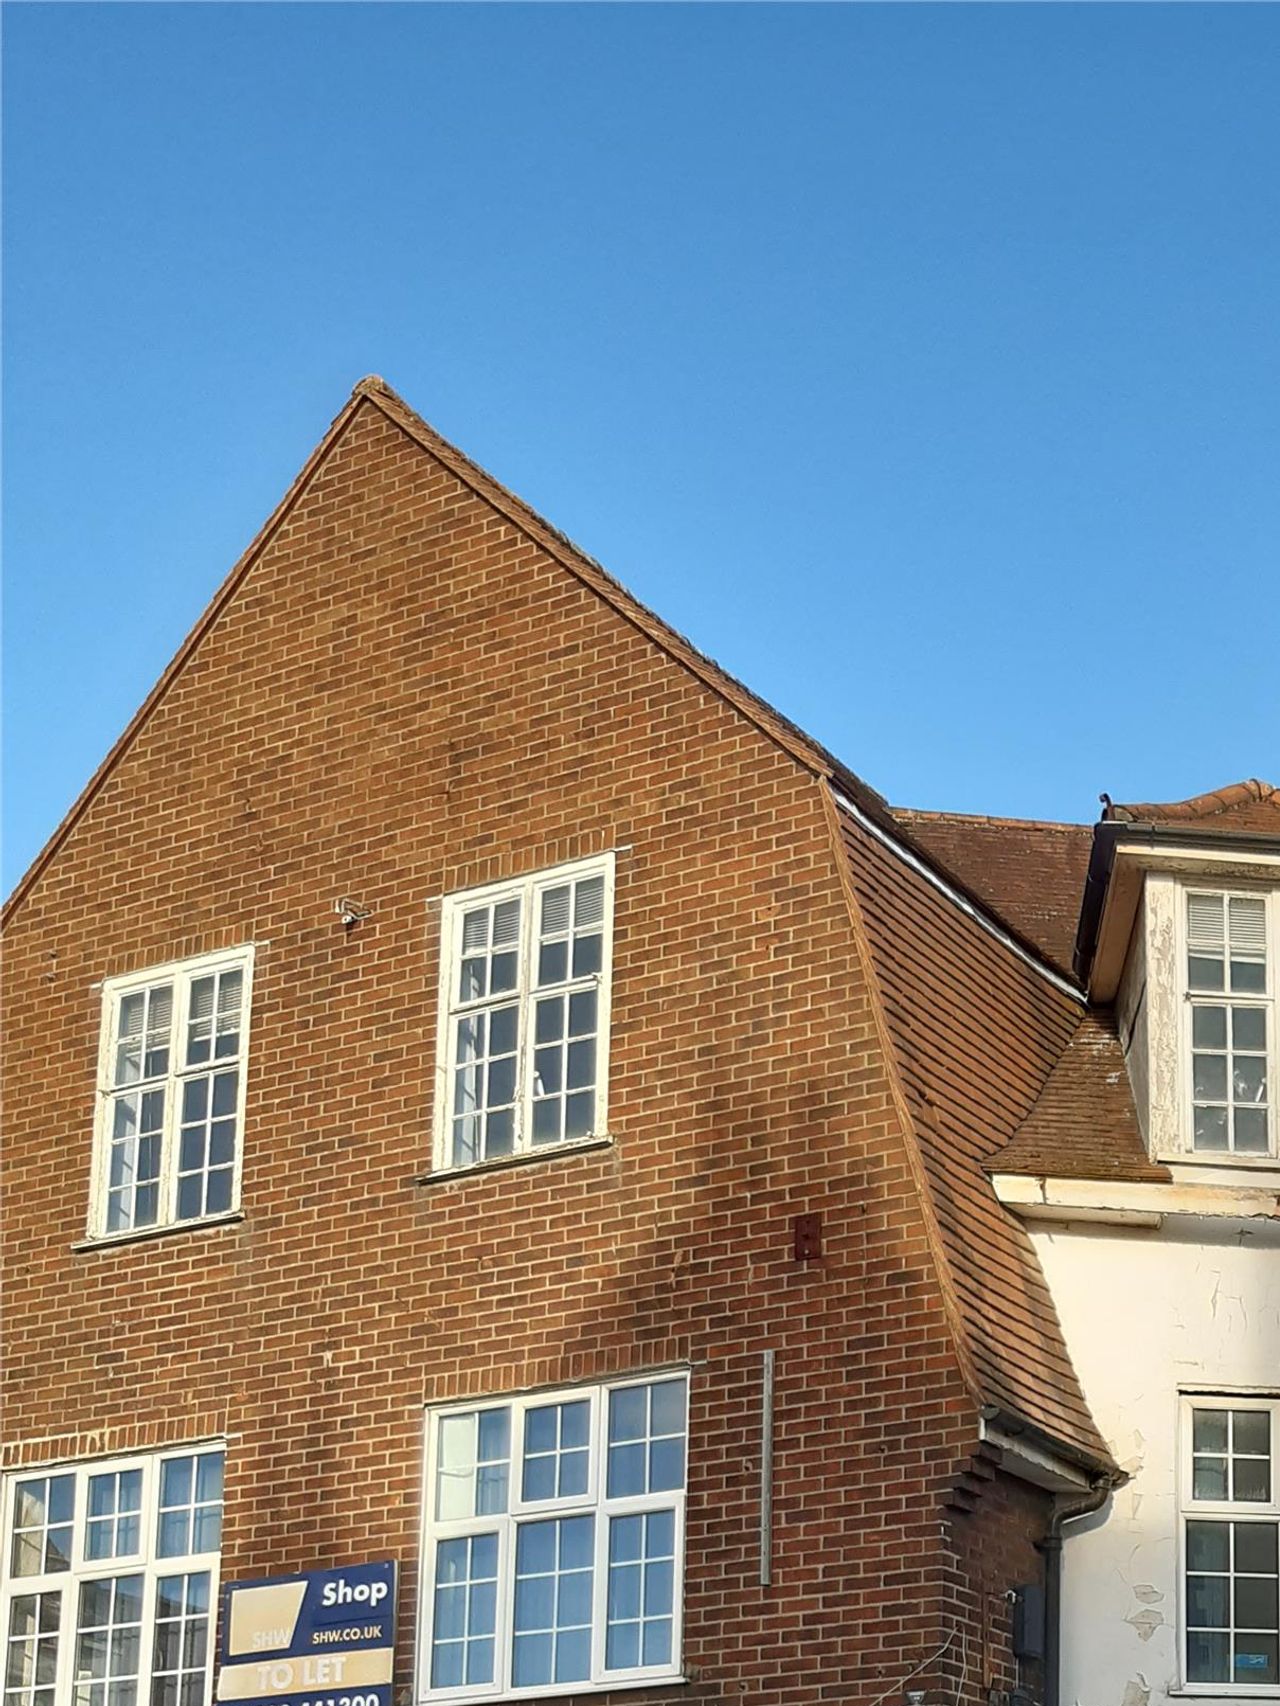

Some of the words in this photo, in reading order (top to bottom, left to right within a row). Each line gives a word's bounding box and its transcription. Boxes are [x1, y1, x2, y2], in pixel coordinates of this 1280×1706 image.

[322, 1579, 388, 1607] Shop
[252, 1627, 290, 1649] SHW
[312, 1625, 382, 1644] SHW.CO.UK
[257, 1663, 294, 1691] TO
[303, 1656, 347, 1686] LET
